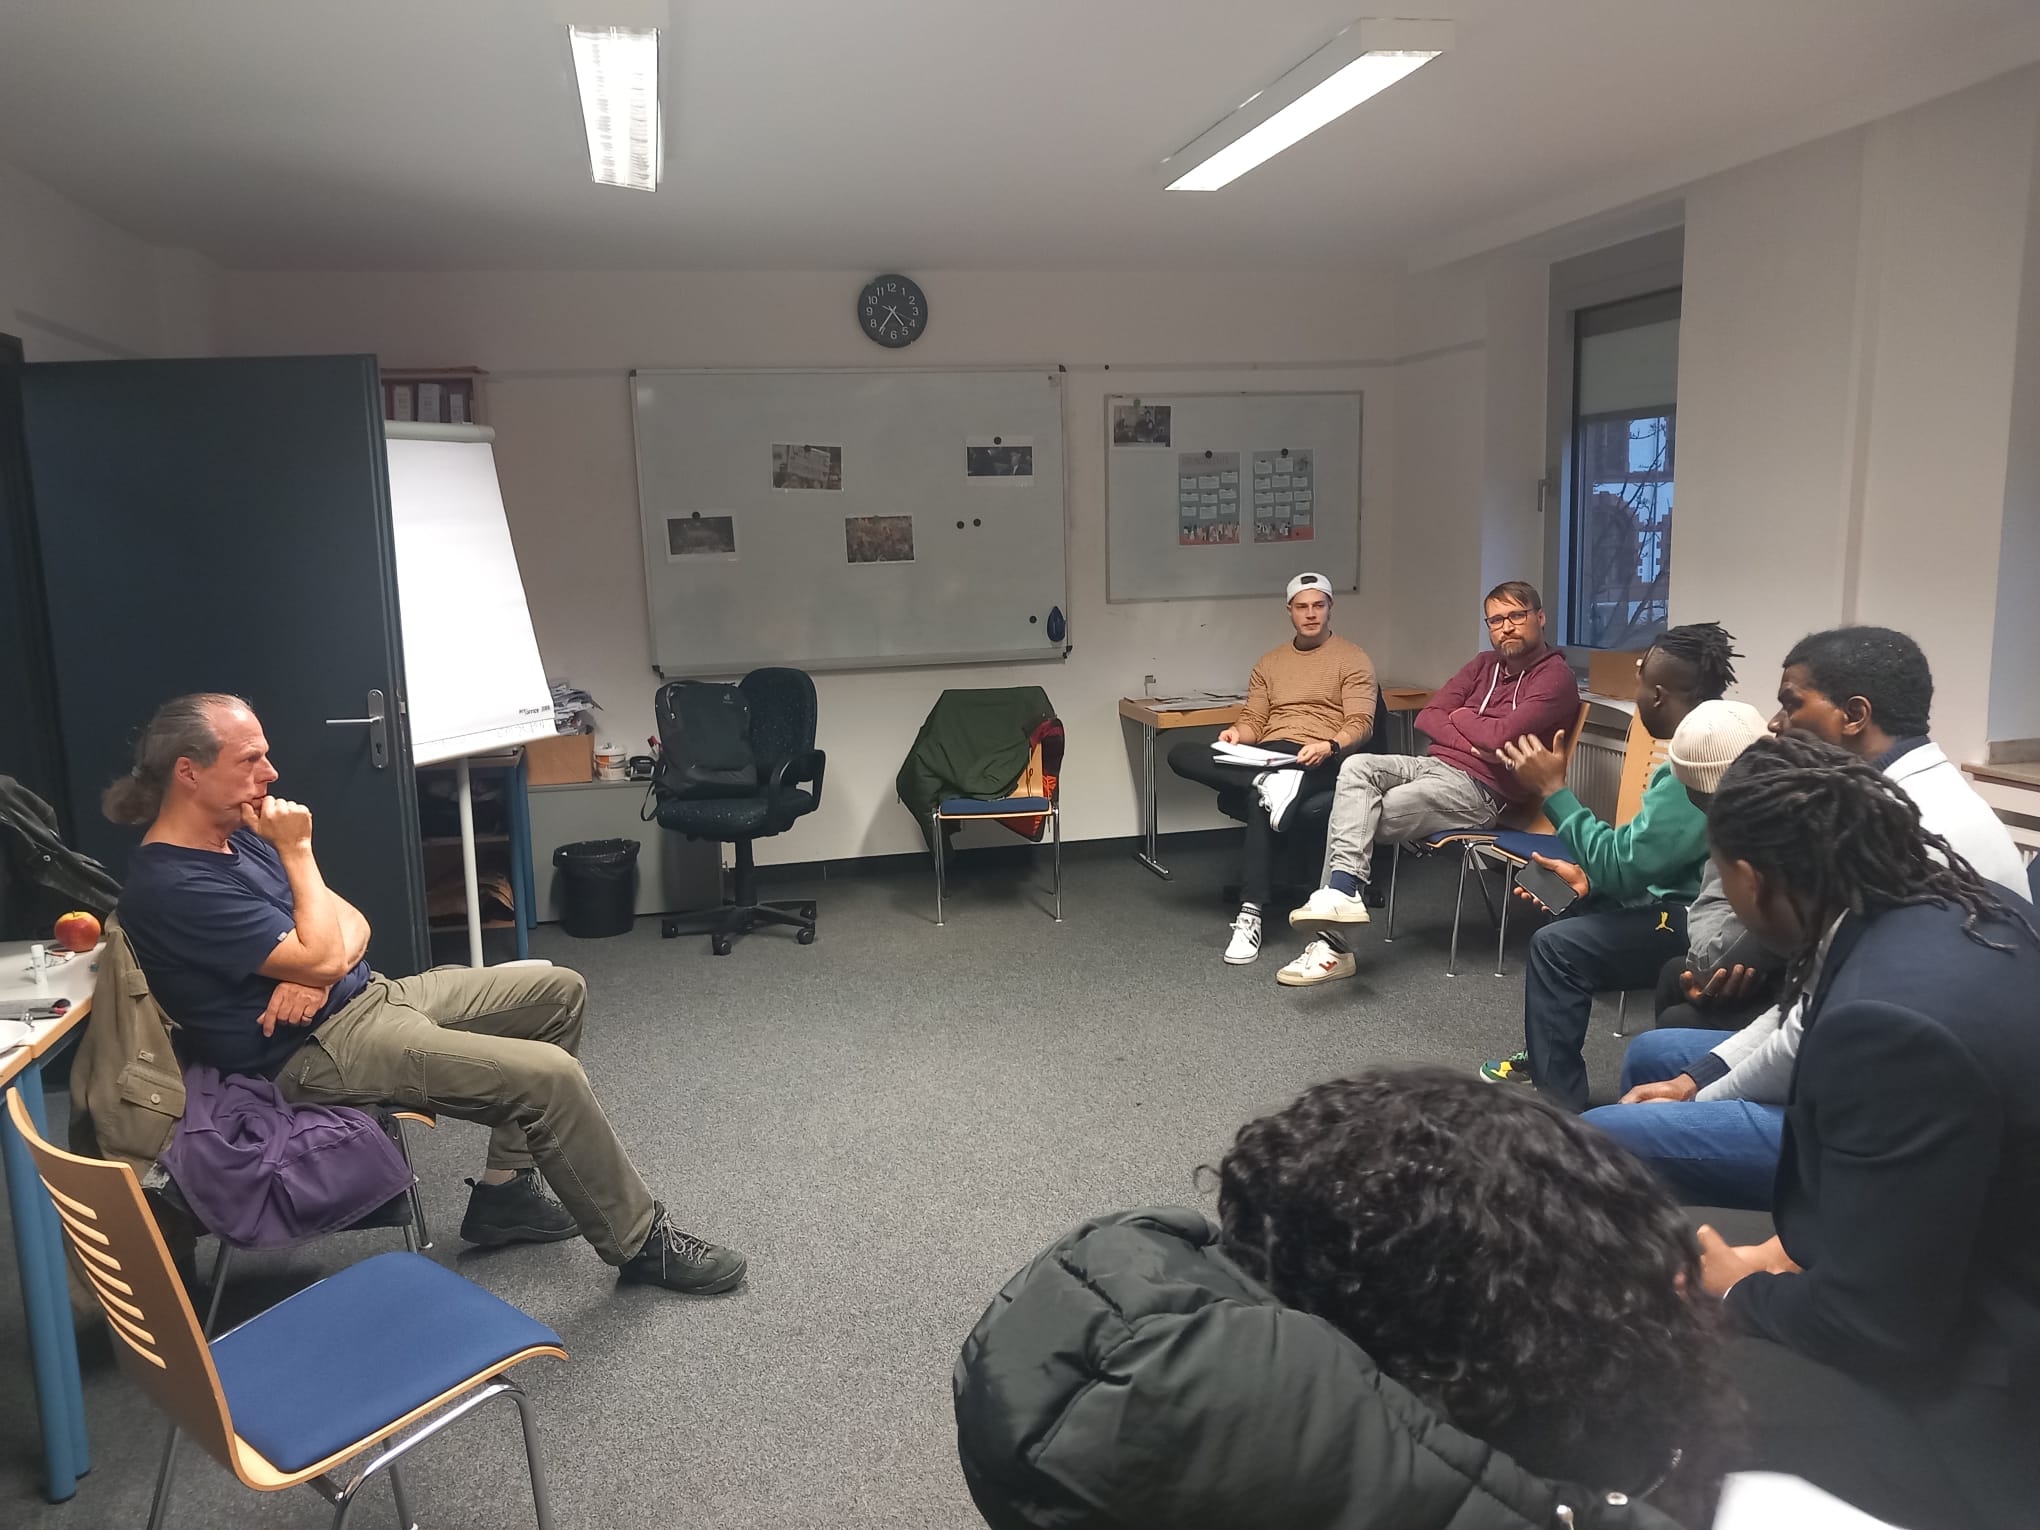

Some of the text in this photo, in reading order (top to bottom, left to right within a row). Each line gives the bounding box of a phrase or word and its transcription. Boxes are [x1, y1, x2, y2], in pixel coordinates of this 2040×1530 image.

[877, 287, 884, 296] 11
[887, 283, 896, 292] 12
[868, 295, 878, 305] 10
[908, 295, 916, 305] 2
[866, 307, 873, 316] 9
[912, 306, 919, 316] 3
[870, 319, 877, 328] 8
[890, 330, 897, 340] 6
[902, 327, 909, 336] 5
